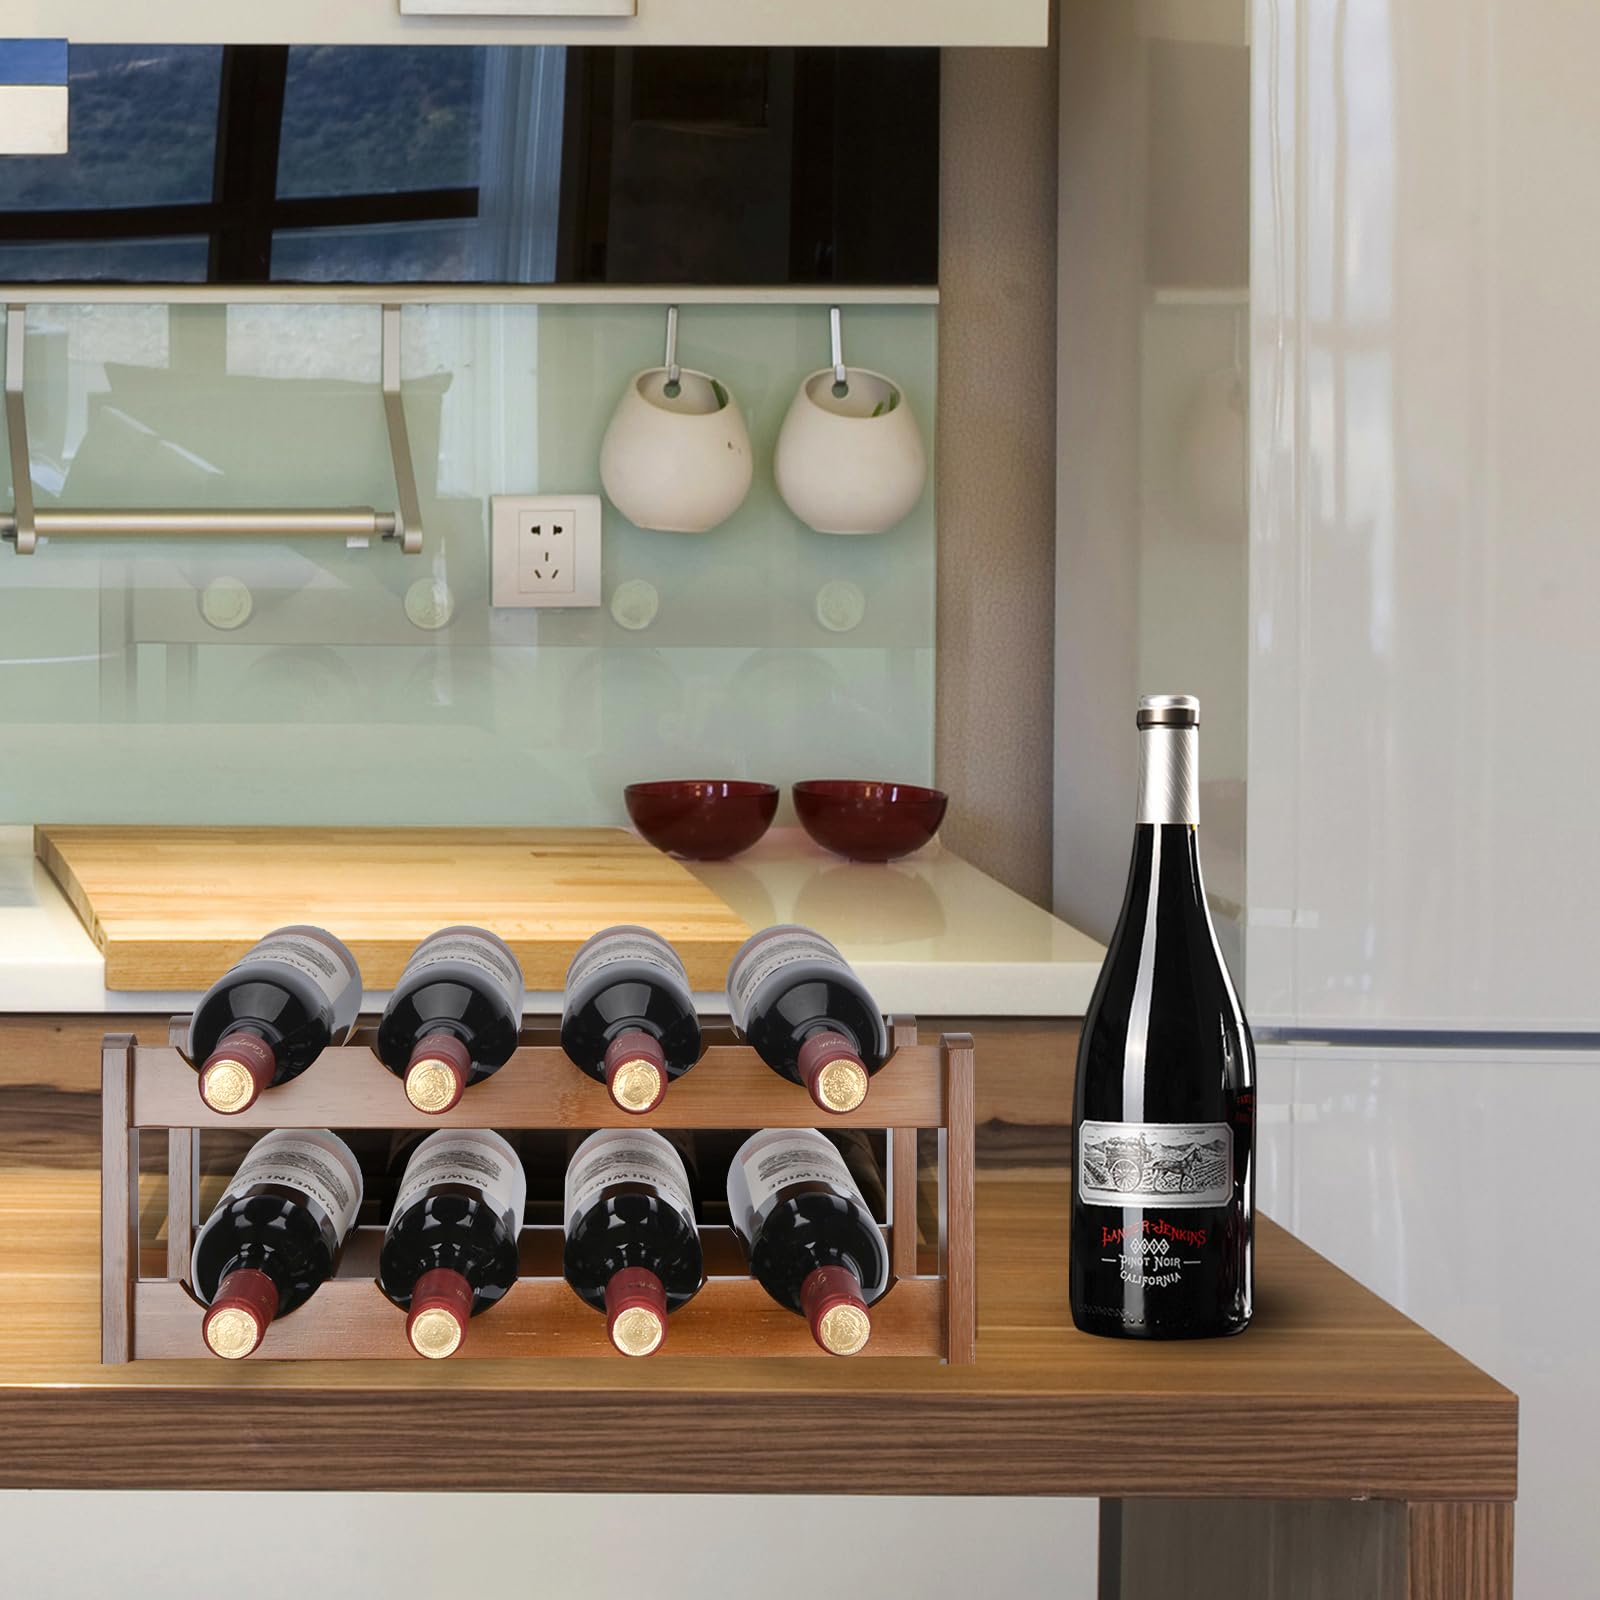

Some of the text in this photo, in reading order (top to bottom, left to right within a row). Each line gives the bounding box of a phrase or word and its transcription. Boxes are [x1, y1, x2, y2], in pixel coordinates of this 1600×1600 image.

[1118, 1254, 1181, 1272] PINOT NOIR
[1120, 1270, 1182, 1288] CALIFORNIA
